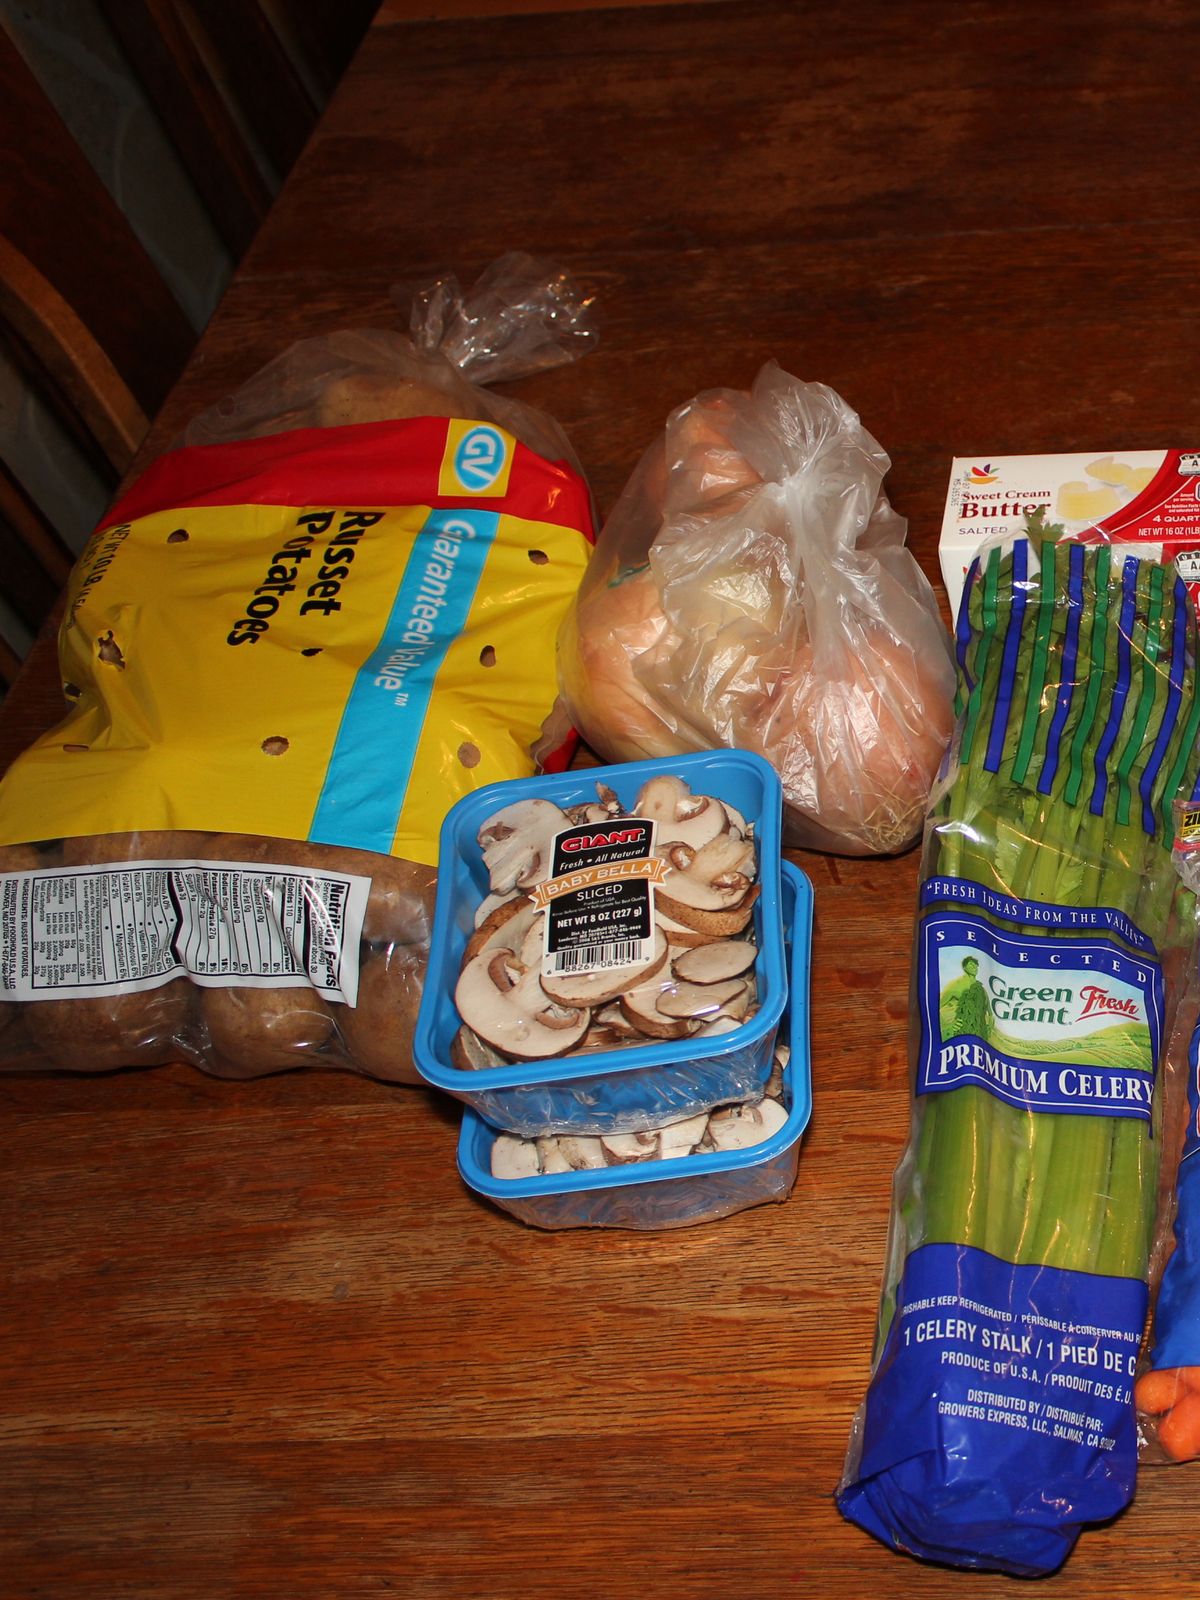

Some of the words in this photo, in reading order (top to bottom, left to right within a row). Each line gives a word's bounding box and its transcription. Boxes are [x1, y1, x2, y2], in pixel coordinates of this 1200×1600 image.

[461, 433, 497, 484] GV
[962, 492, 1002, 501] Sweet
[1005, 490, 1051, 499] Cream
[958, 526, 1008, 535] SALTED
[1138, 527, 1152, 537] NET
[1152, 527, 1164, 536] WT
[1165, 527, 1174, 535] 16
[1174, 526, 1184, 535] OZ
[1152, 514, 1162, 523] 4
[226, 510, 337, 647] Potatoes
[299, 510, 386, 617] Russet
[401, 519, 477, 649] Guaranteed
[561, 828, 645, 853] GIANT
[559, 858, 584, 871] Fresh
[594, 853, 608, 863] All
[610, 846, 645, 860] Natural
[174, 871, 183, 893] Protein
[232, 873, 240, 909] Cholesterol
[286, 877, 294, 904] Calories
[545, 872, 594, 896] BABY
[596, 861, 653, 879] BELLA
[576, 884, 623, 902] SLICED
[9, 879, 19, 916] DISTRIBUTED
[20, 878, 30, 921] INGREDIENTS:
[286, 905, 294, 917] 110
[982, 890, 1018, 917] IDEAS
[1024, 906, 1063, 924] FROM
[1069, 912, 1098, 924] THE
[20, 921, 29, 946] RUSSET
[122, 873, 130, 892] Folate
[126, 927, 136, 967] Phosphorous
[557, 919, 573, 929] NET
[574, 915, 588, 926] WT
[590, 914, 596, 923] 8
[597, 912, 611, 921] OZ
[612, 908, 631, 920] (227
[633, 906, 642, 917] g)
[21, 946, 29, 978] POTATOES.
[324, 950, 337, 987] Facts
[564, 963, 596, 973] 88267
[600, 958, 632, 968] 08424
[935, 929, 1147, 985] SELECTED
[987, 975, 1074, 1003] Green
[1078, 984, 1141, 1017] Fresh
[989, 997, 1070, 1026] Giant
[937, 1042, 1049, 1096] PREMIUM
[1058, 1067, 1154, 1105] CELERY
[902, 1297, 936, 1315] RISHABLE
[937, 1295, 958, 1306] KEEP
[959, 1297, 1012, 1322] REFRIGERATED
[1021, 1312, 1067, 1333] PÉRISSABLE
[1075, 1324, 1122, 1340] CONSERVER
[1123, 1333, 1134, 1343] AU
[904, 1326, 911, 1346] 1
[916, 1318, 977, 1343] CELERY
[981, 1327, 1032, 1355] STALK
[1046, 1341, 1053, 1361] 1
[1060, 1344, 1098, 1366] PIED
[1103, 1350, 1123, 1373] DE
[940, 1351, 991, 1373] PRODUCE
[993, 1362, 1008, 1375] OF
[1010, 1364, 1042, 1385] U.S.A.
[1051, 1373, 1094, 1394] PRODUIT
[1094, 1382, 1114, 1400] DES
[937, 1400, 986, 1422] GROWERS
[987, 1410, 1031, 1432] EXPRESS,
[1053, 1424, 1085, 1446] SALINAS,
[1087, 1433, 1099, 1448] CA
[967, 1388, 1028, 1411] DISTRIBUTED
[1028, 1401, 1041, 1416] BY
[1046, 1405, 1086, 1427] DISTRIBUÉ
[1085, 1416, 1104, 1432] PAR:
